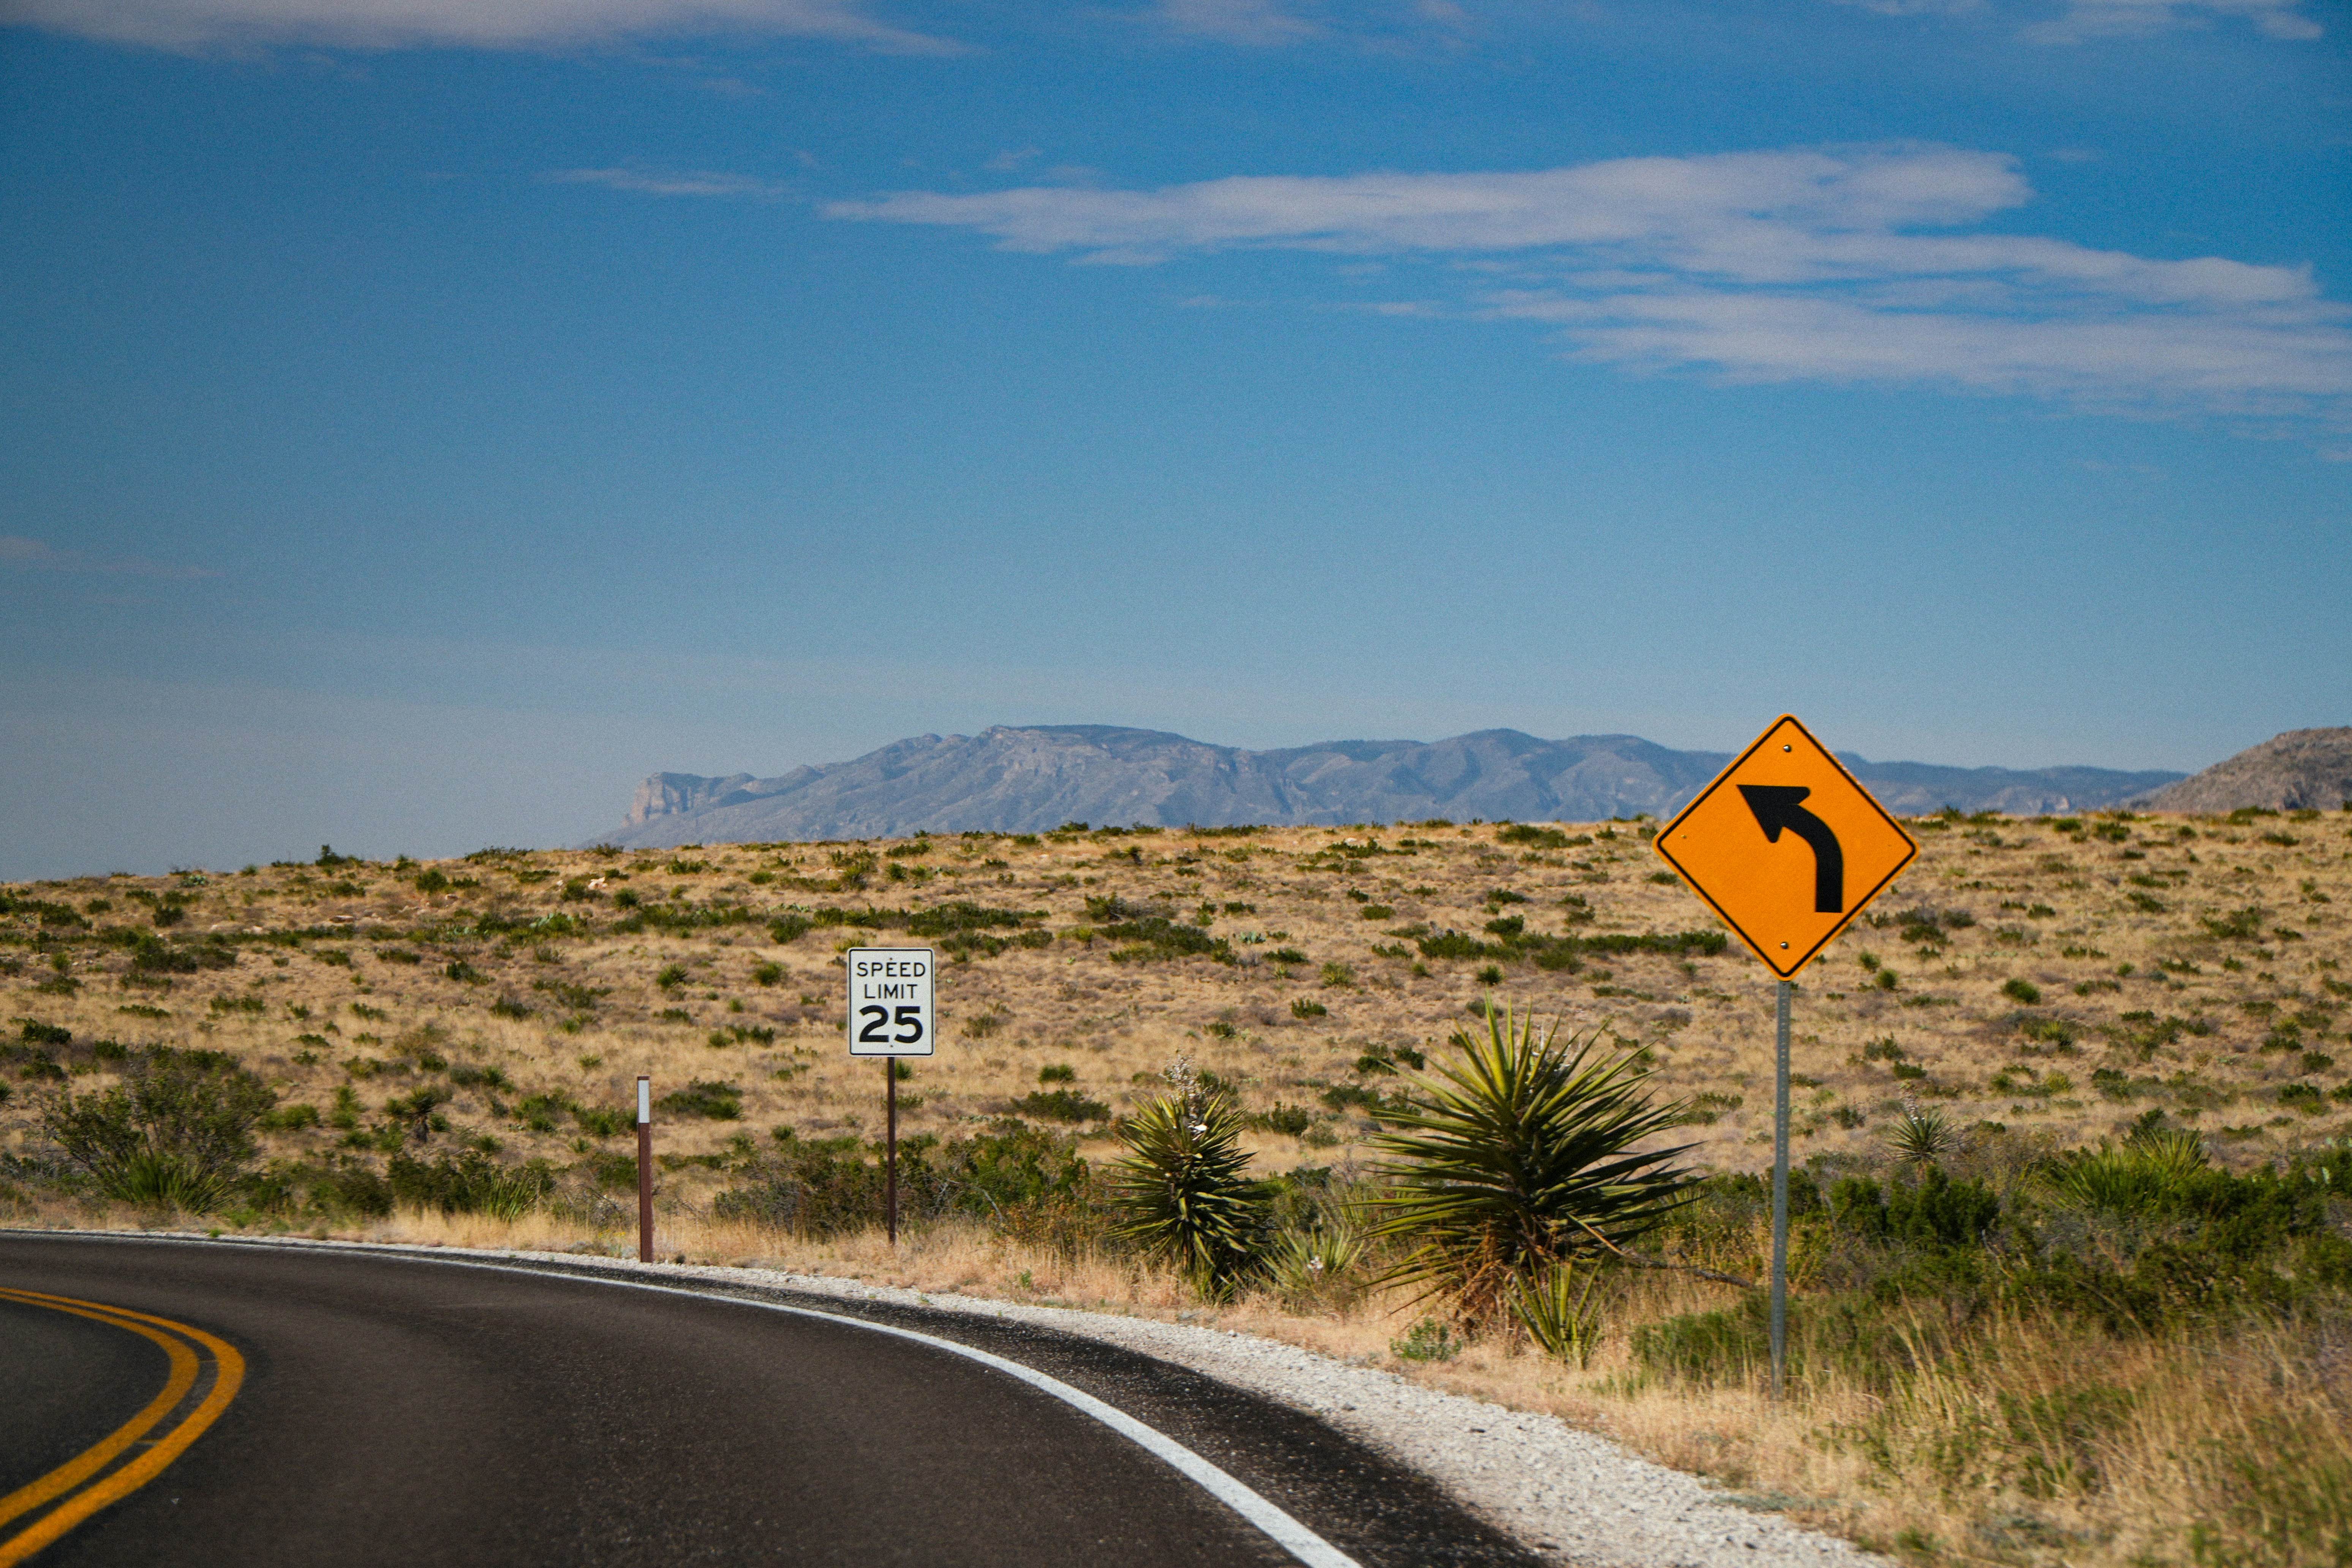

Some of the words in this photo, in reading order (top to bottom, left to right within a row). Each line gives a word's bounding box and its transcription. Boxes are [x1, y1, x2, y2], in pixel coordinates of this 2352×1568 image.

[857, 962, 926, 977] SPEED
[864, 984, 918, 999] LIMIT
[859, 1005, 923, 1043] 25
